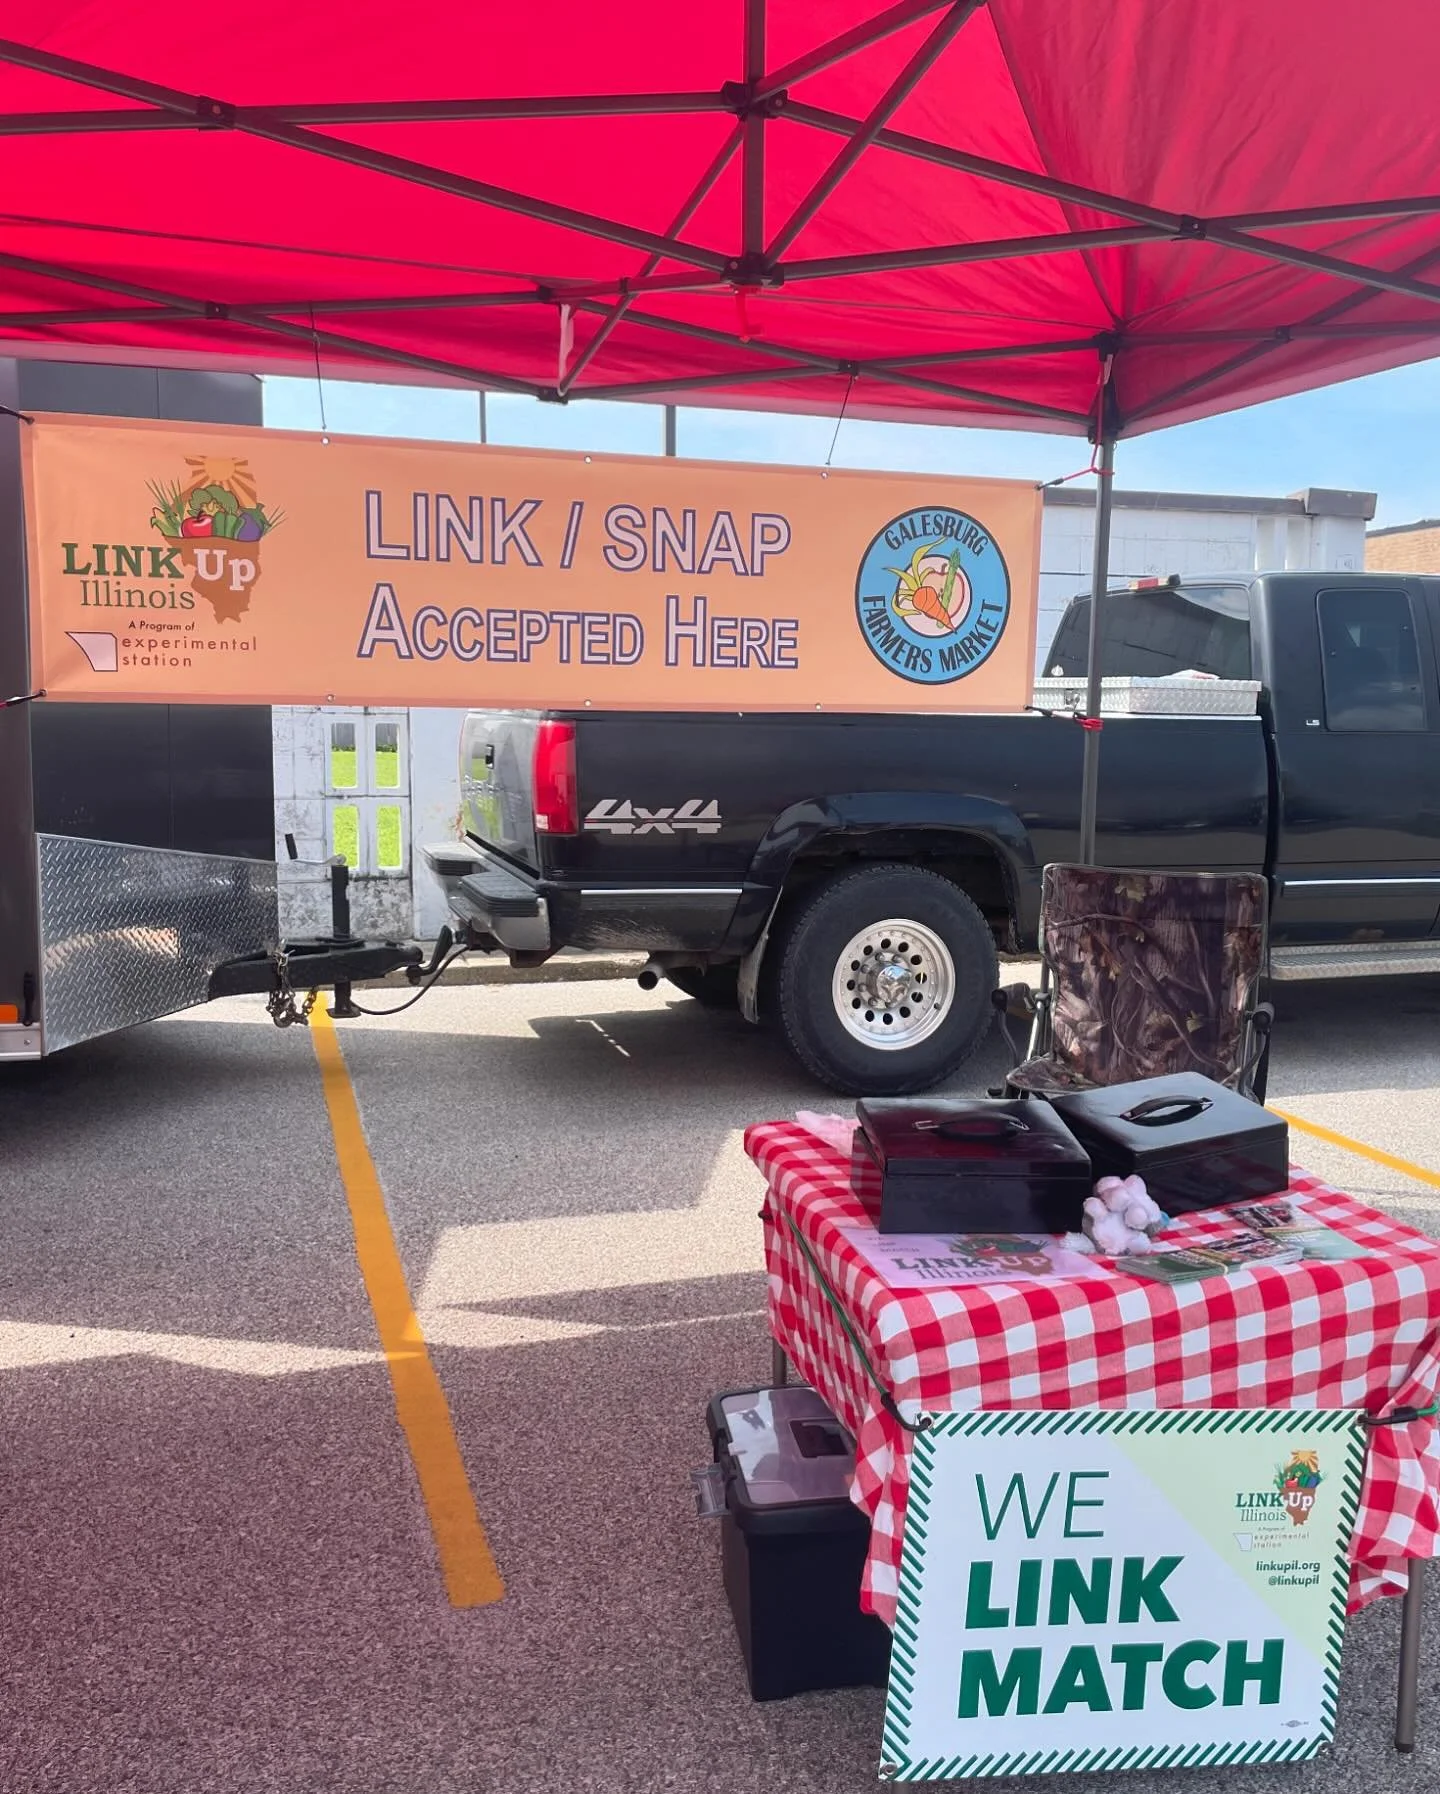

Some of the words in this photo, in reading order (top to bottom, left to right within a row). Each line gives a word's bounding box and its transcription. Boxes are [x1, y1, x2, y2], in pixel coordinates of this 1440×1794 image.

[365, 489, 544, 567] LINK
[559, 501, 584, 569] /
[602, 504, 792, 577] SNAP
[884, 513, 989, 556] GALESBURG
[61, 542, 185, 579] LINK
[194, 549, 256, 591] Up
[80, 580, 196, 610] Illinois
[128, 620, 137, 630] A
[140, 620, 182, 633] Program
[185, 621, 196, 632] of
[863, 595, 933, 673] FARMERS
[939, 599, 1004, 673] MARKET
[122, 636, 257, 652] experimental
[123, 654, 192, 667] station
[891, 1257, 993, 1269] LINK
[974, 1471, 1110, 1541] WE
[1236, 1493, 1284, 1507] LINK
[1288, 1492, 1313, 1511] Up
[1240, 1509, 1288, 1522] Illinois
[1256, 1560, 1320, 1573] linkupil.org
[1268, 1575, 1319, 1586] @linkupil
[965, 1556, 1185, 1630] LINK
[957, 1638, 1285, 1719] MATCH
